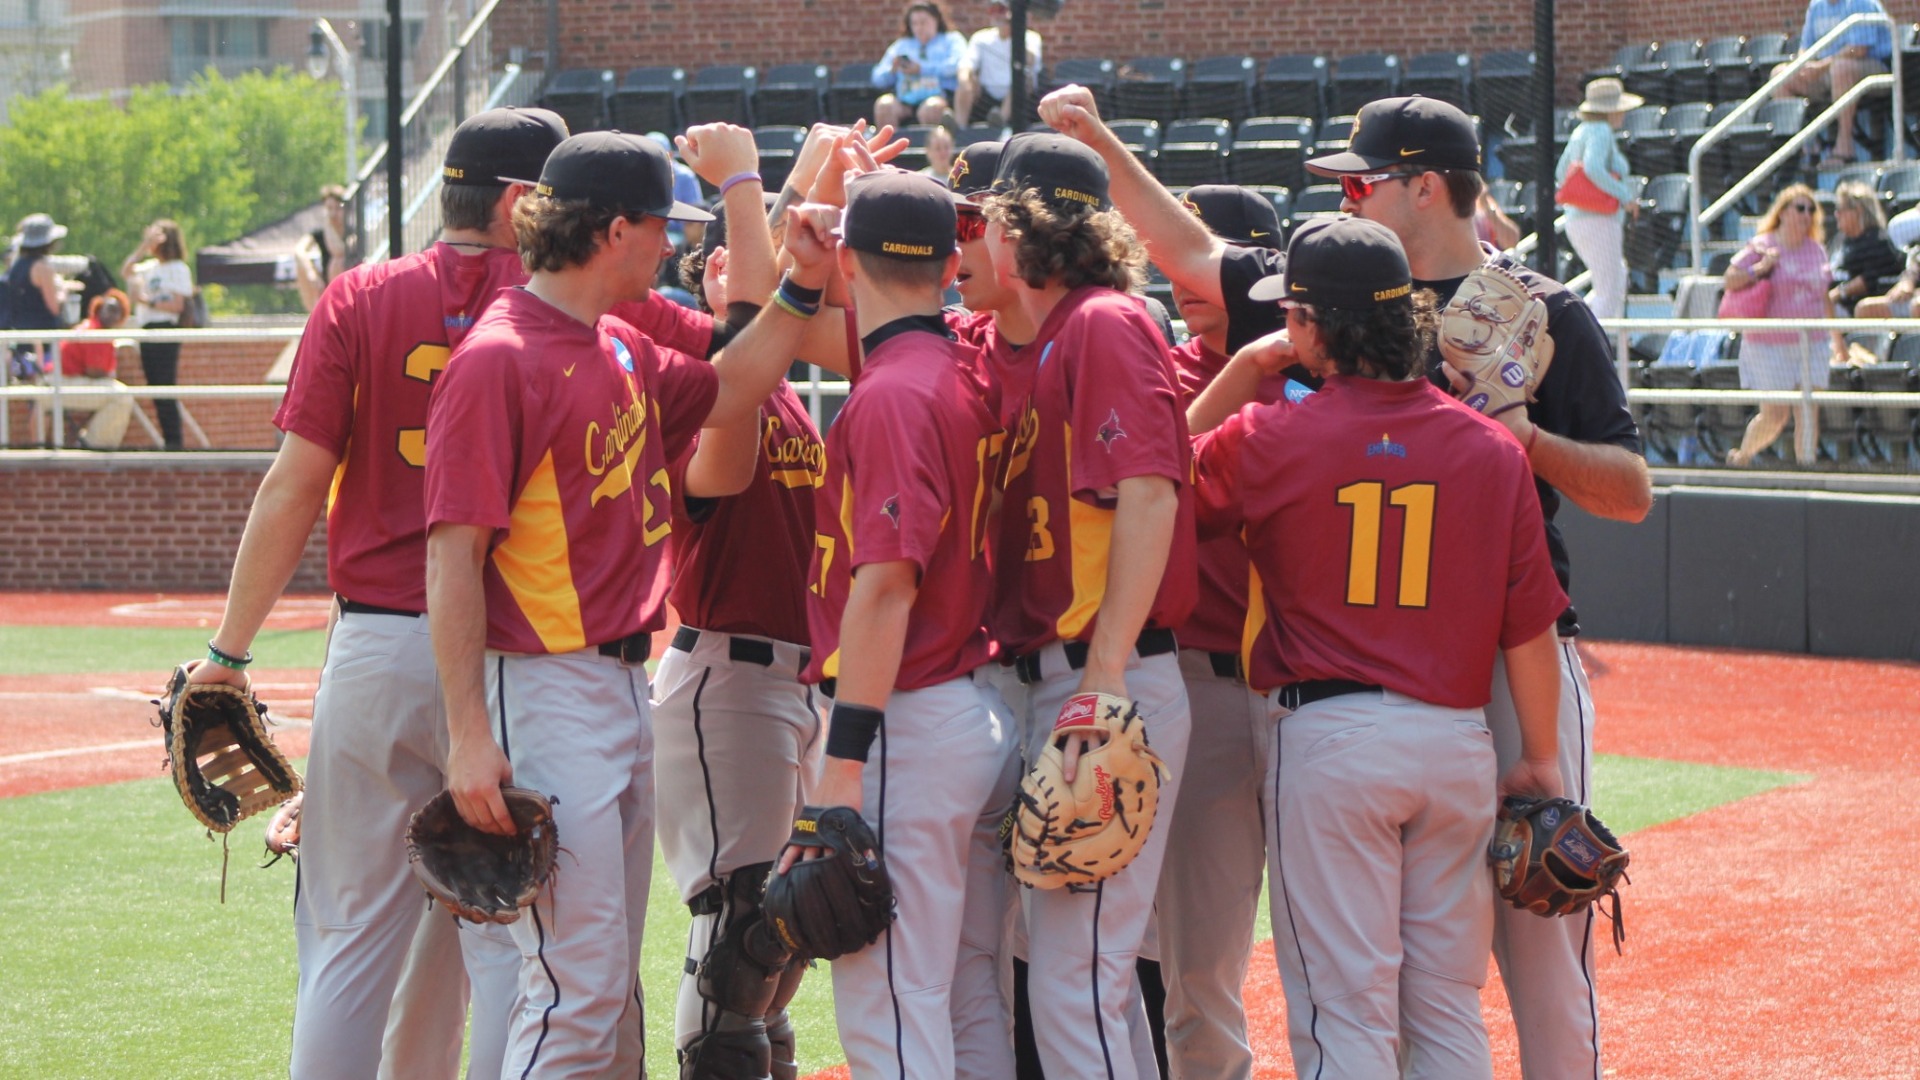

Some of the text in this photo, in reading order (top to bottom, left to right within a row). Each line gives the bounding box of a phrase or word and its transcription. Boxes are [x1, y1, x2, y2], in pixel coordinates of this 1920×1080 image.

[1054, 187, 1100, 207] CARDINALS
[882, 242, 933, 256] CARDINALS
[1336, 480, 1438, 609] 11
[1094, 765, 1115, 820] Rawlings
